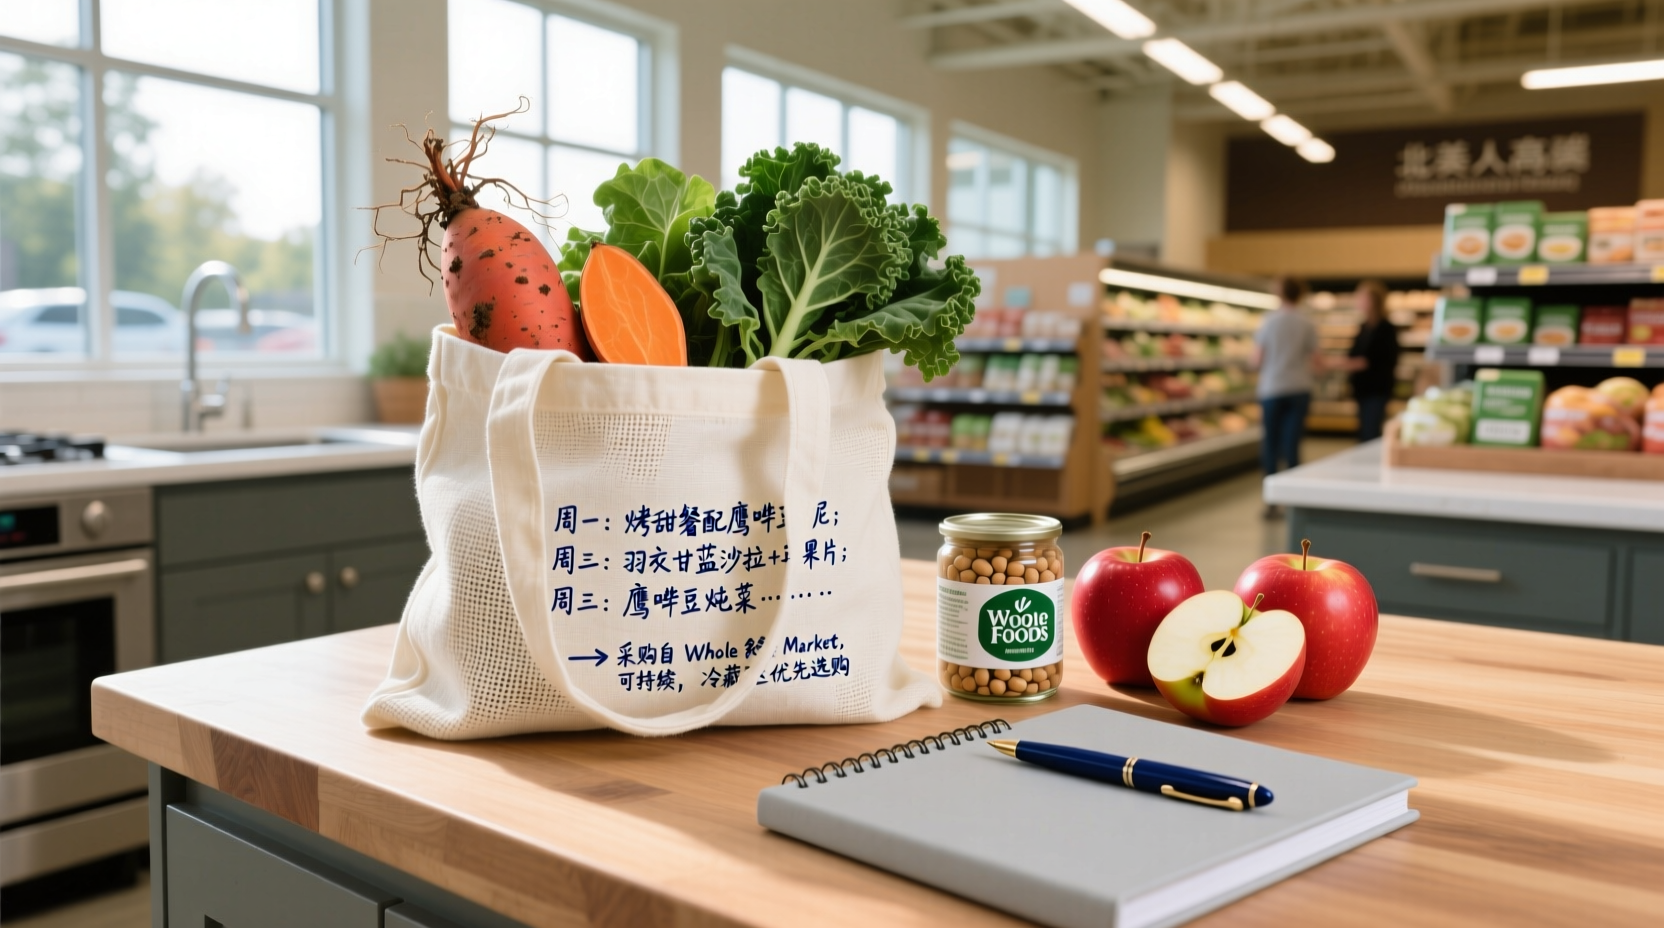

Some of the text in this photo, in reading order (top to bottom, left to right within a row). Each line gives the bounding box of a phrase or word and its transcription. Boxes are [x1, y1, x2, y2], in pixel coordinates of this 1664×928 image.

[617, 641, 674, 667] 采购自
[684, 641, 738, 663] Whole
[783, 634, 845, 655] Market,
